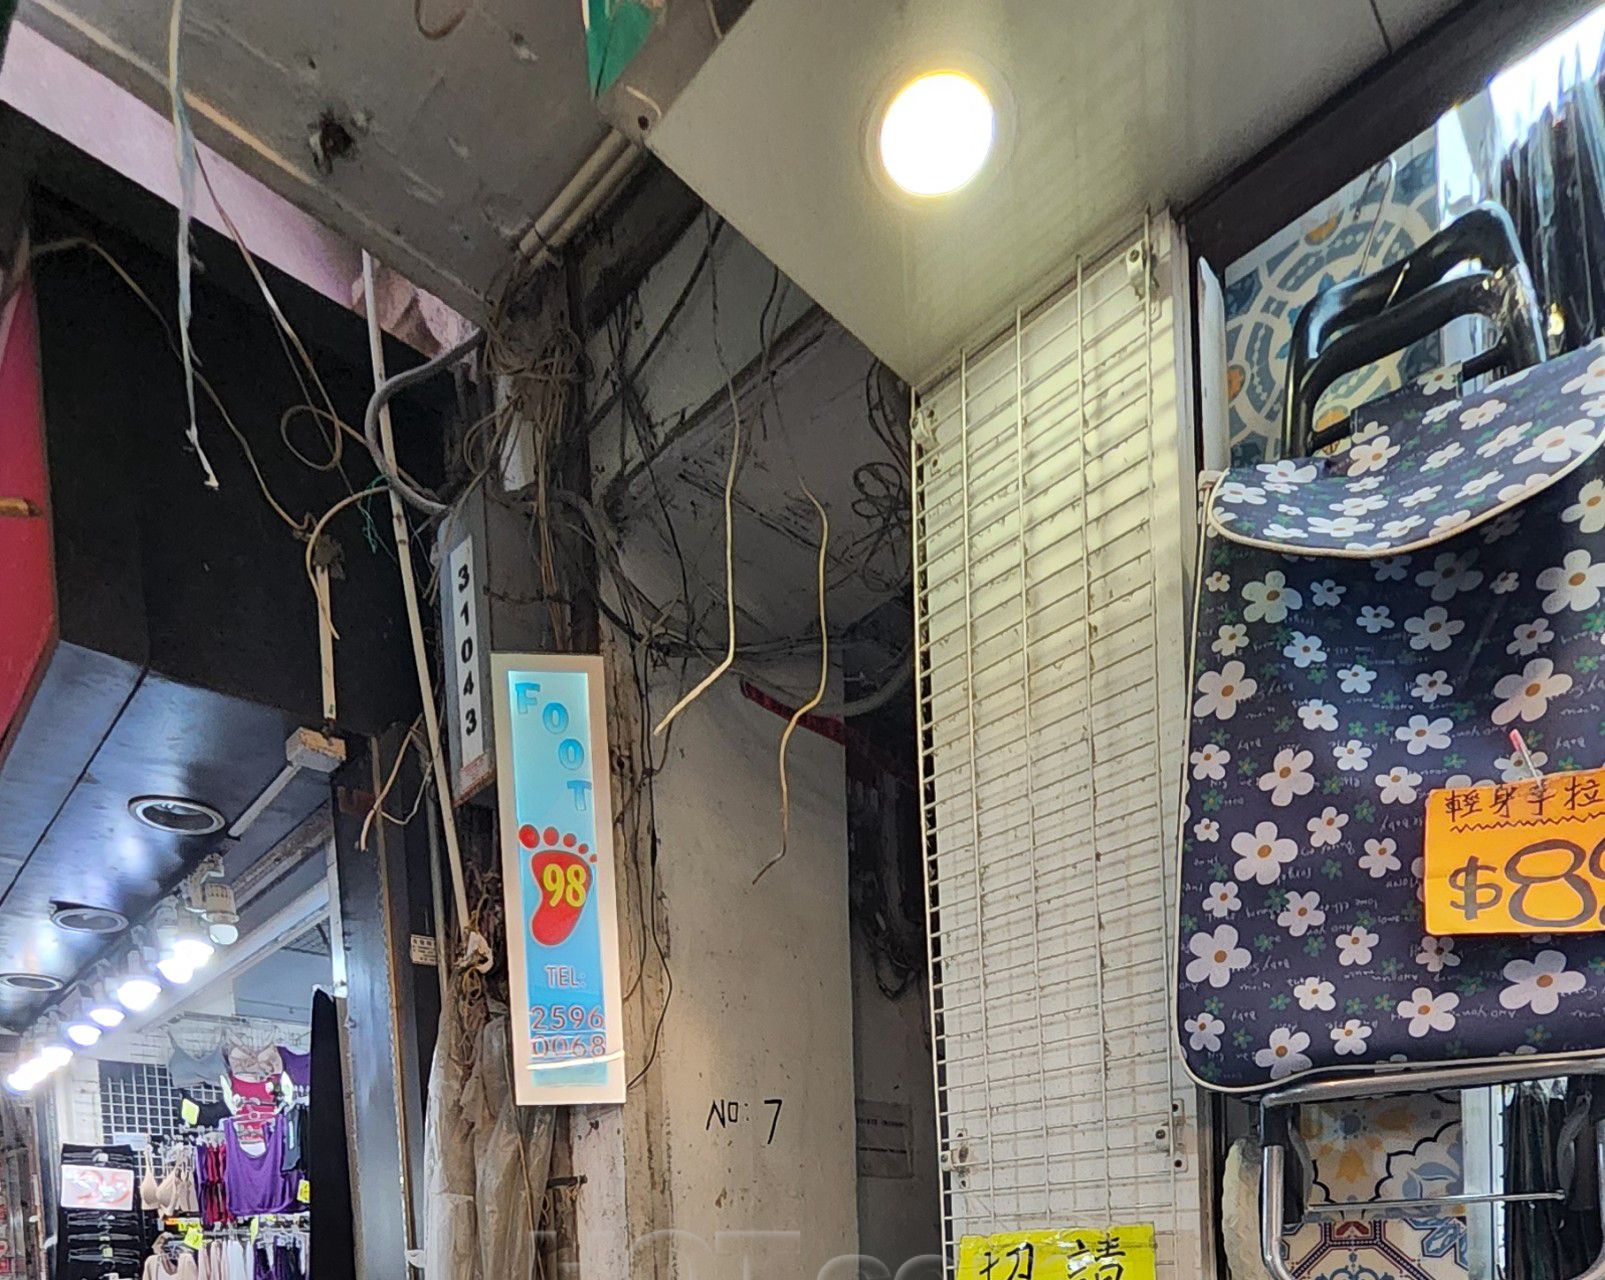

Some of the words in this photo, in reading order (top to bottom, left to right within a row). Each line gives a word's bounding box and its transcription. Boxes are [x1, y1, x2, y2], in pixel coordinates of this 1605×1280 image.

[543, 863, 587, 908] 98
[530, 1006, 604, 1030] 2596
[532, 1034, 606, 1058] 0068
[764, 1098, 783, 1145] 7
